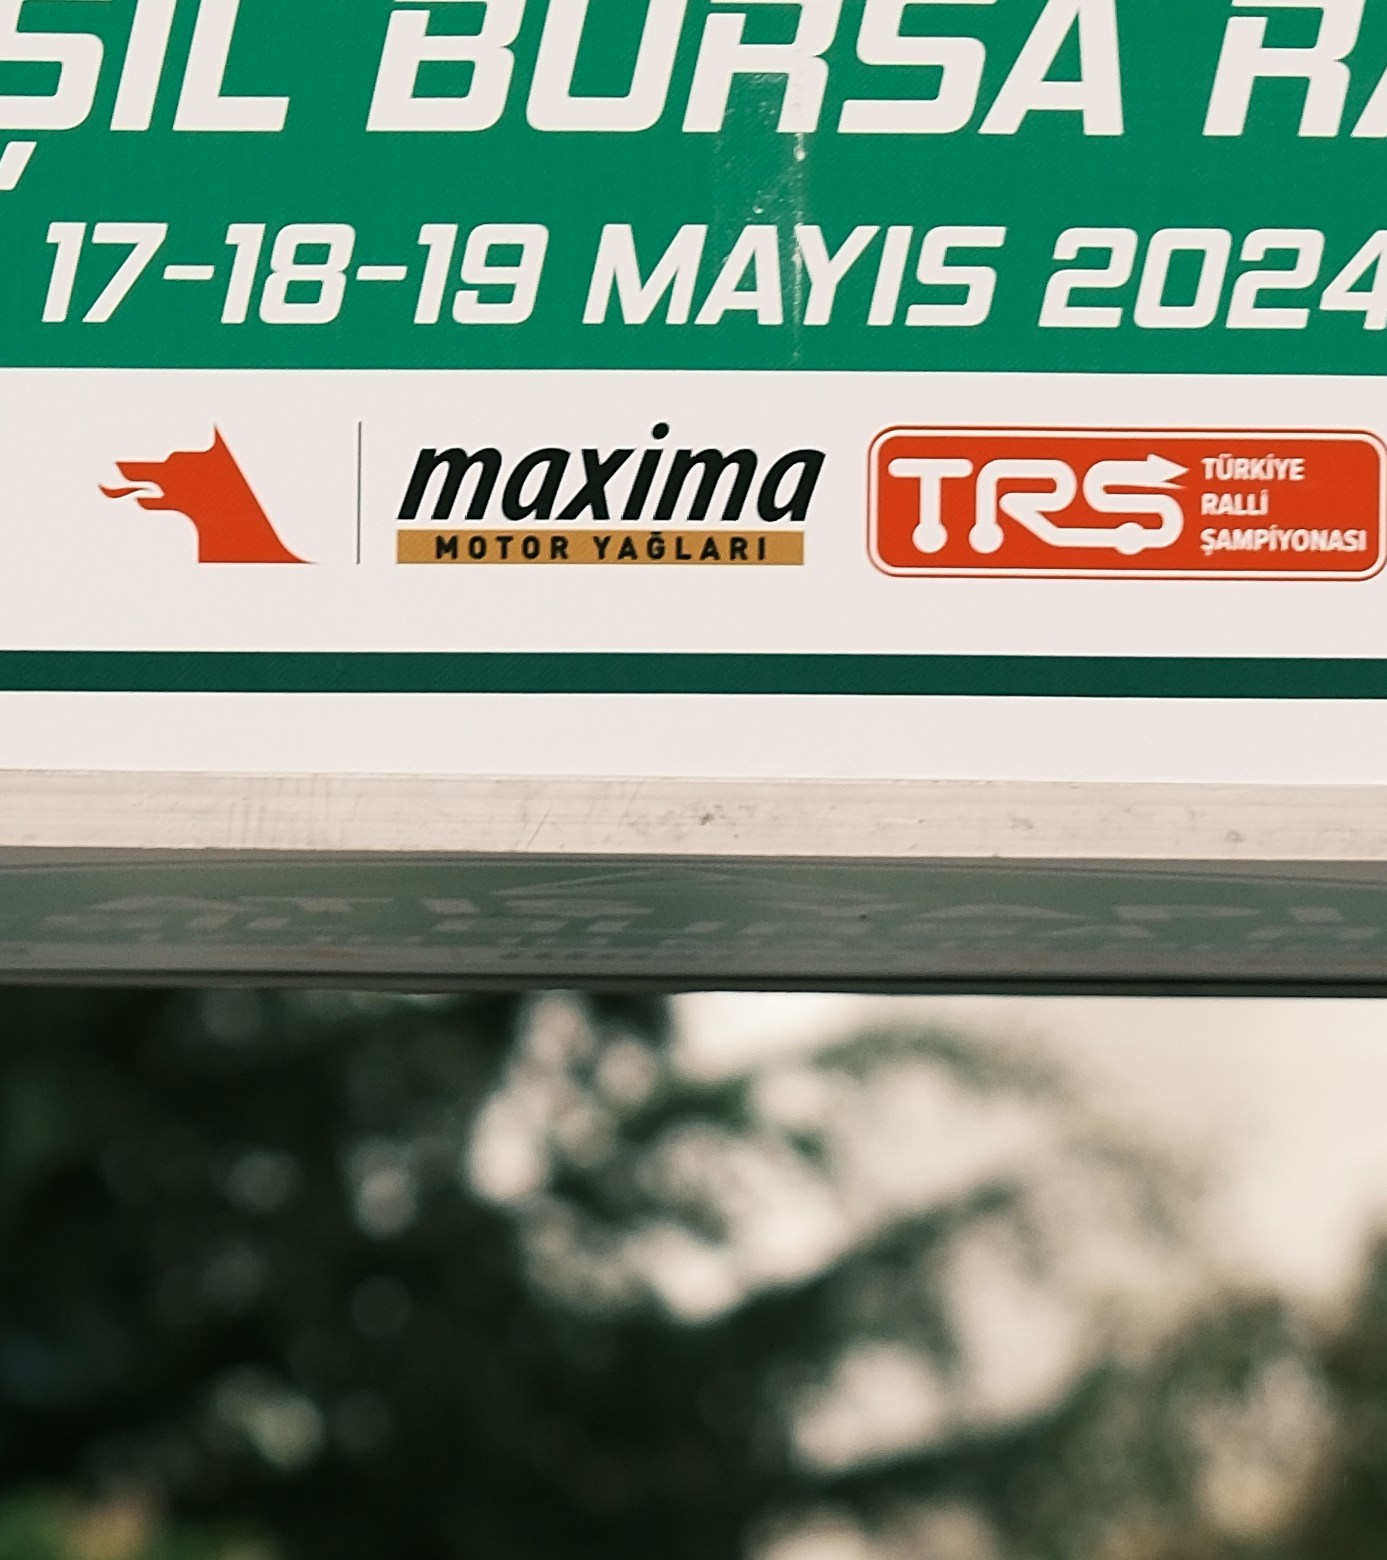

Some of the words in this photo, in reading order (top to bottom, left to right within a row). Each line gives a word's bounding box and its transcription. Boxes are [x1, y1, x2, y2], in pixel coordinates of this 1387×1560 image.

[366, 0, 1123, 135] BURSA
[42, 222, 549, 325] 17-18-19
[583, 224, 1006, 328] MAYIS
[396, 422, 826, 522] maxima
[1201, 453, 1306, 481] TÜRKİYE
[888, 454, 1188, 555] TRS
[1201, 489, 1269, 516] RALLİ
[435, 535, 569, 560] MOTOR
[593, 530, 766, 561] YAĞLARI
[1200, 524, 1367, 556] ŞAMPİYONASI
